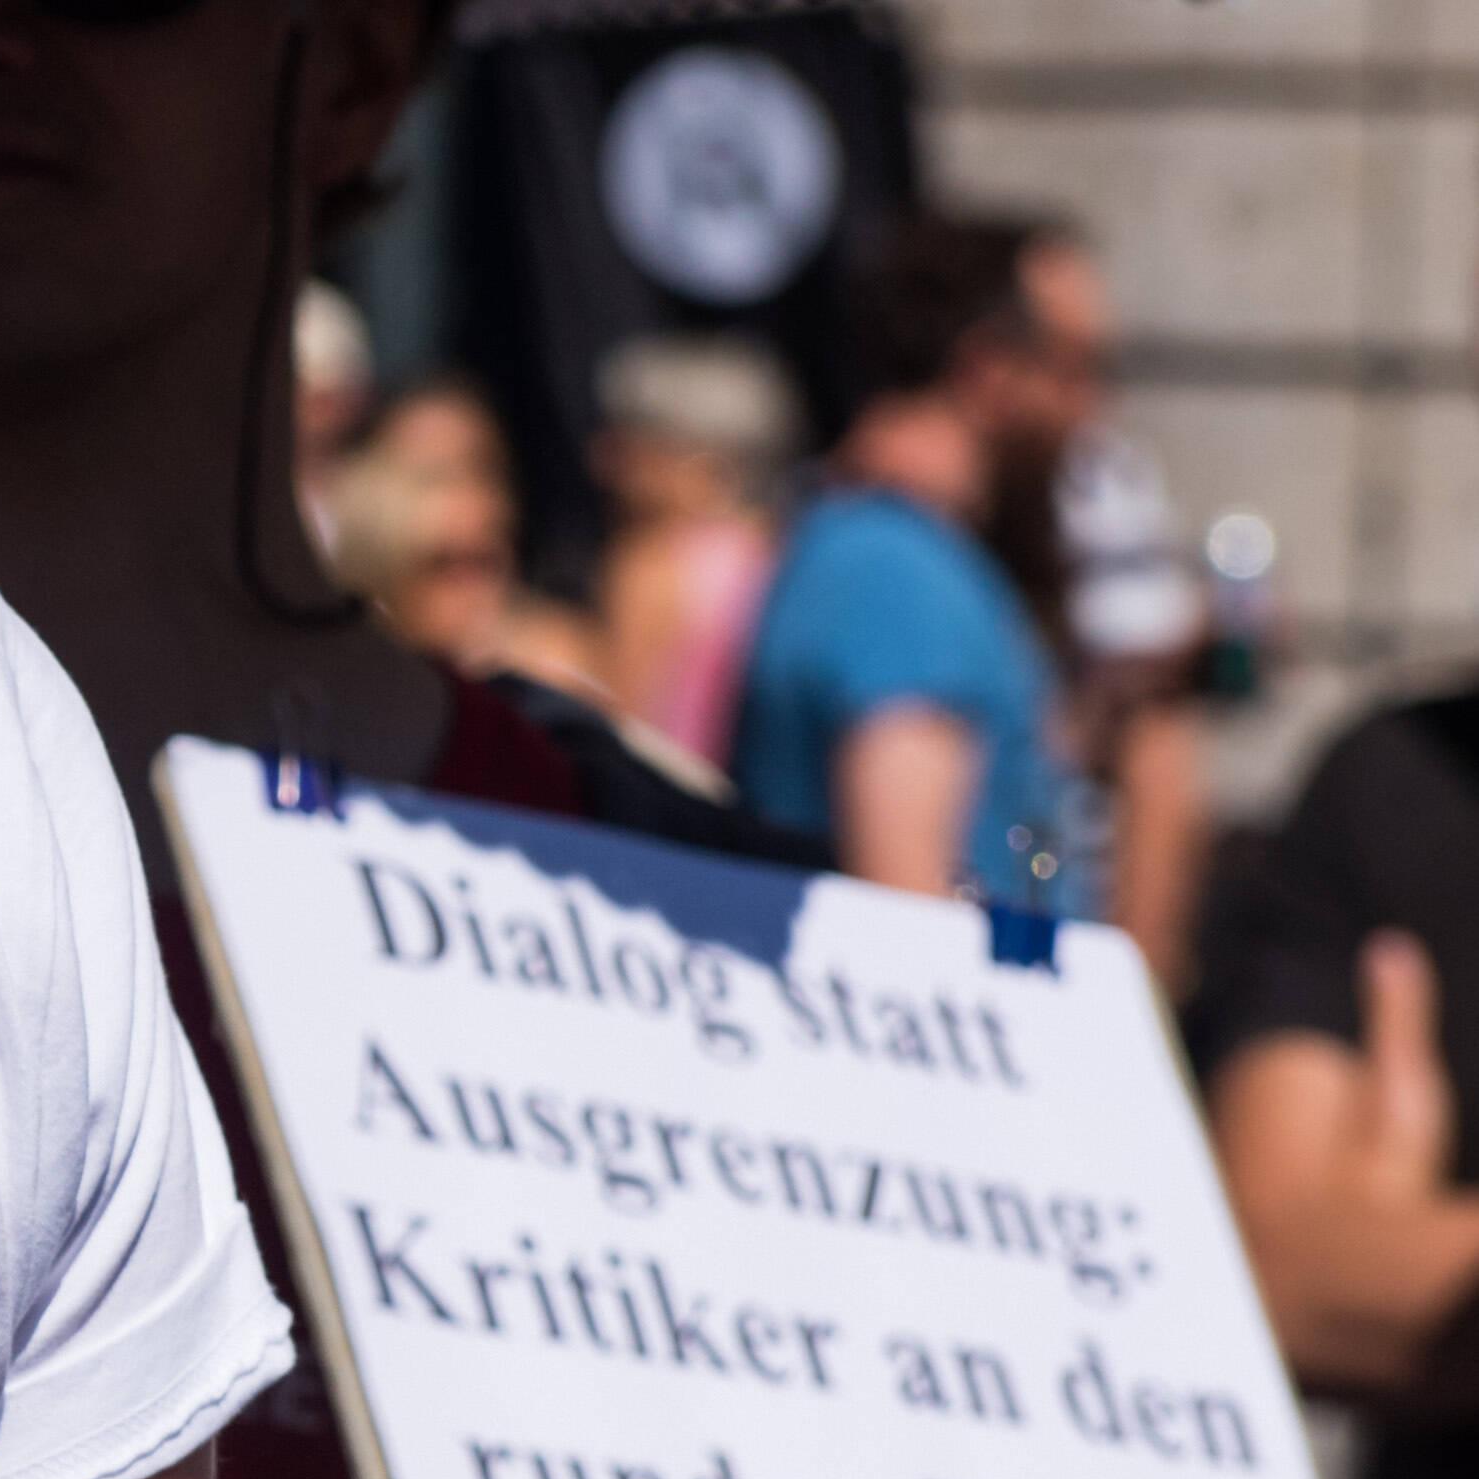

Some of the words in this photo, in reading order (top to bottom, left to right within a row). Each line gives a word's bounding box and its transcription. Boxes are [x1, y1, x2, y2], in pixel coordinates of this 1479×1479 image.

[354, 855, 760, 1066] Dialog
[777, 962, 1028, 1092] statt
[352, 1035, 1154, 1306] Ausgrenzung:
[350, 1200, 837, 1388] Kritiker
[882, 1333, 1026, 1426] an
[1058, 1335, 1262, 1469] den
